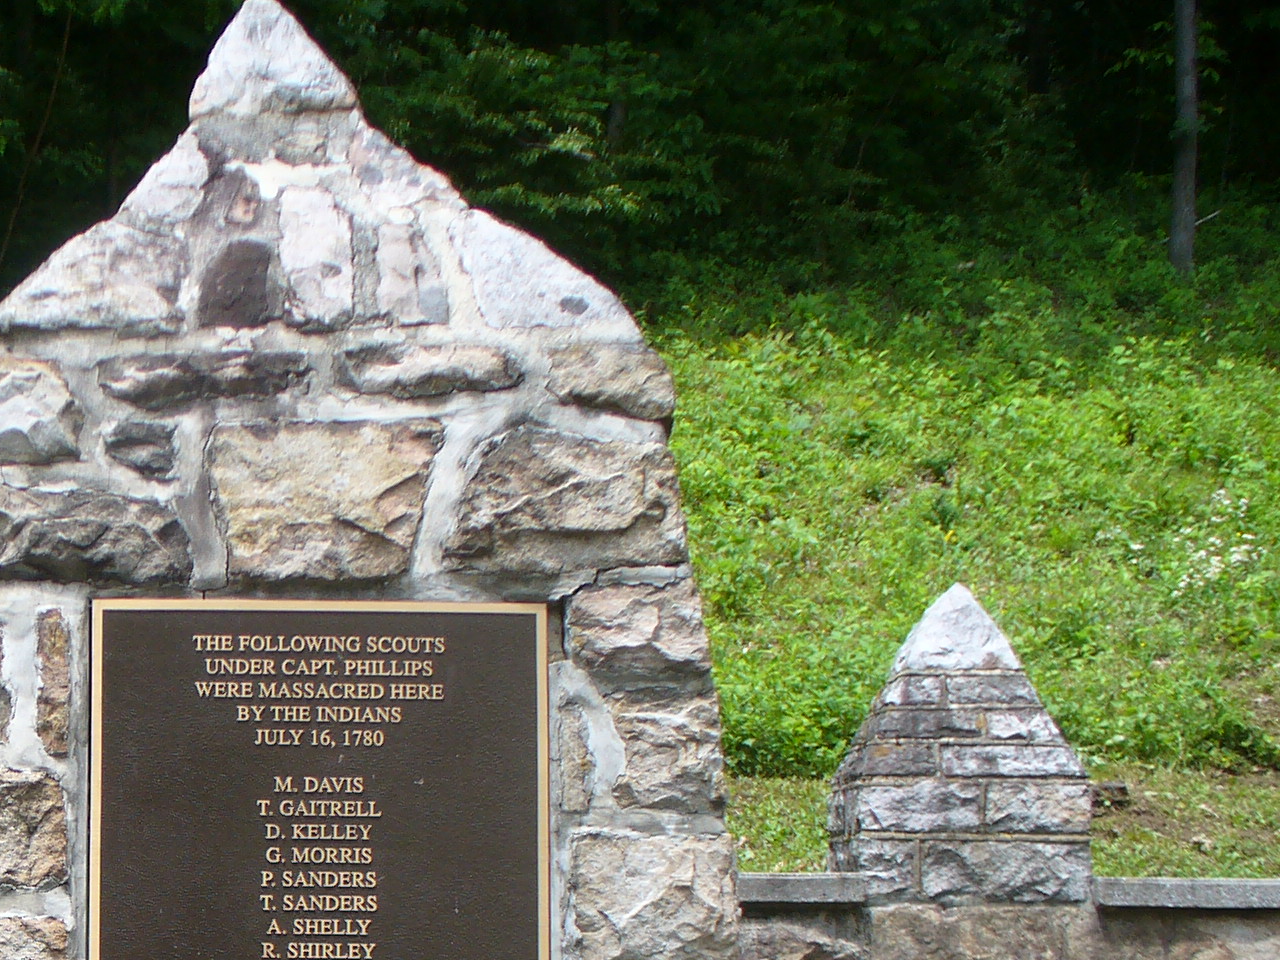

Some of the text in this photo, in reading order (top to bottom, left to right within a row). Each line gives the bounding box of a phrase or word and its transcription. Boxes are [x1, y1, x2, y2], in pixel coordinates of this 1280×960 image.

[191, 634, 446, 653] THE FOLLOWING SCOUTS
[204, 658, 433, 677] UNDER CAPT. PHILLIPS
[194, 680, 445, 700] WERE MASSACRED HERE
[236, 705, 402, 723] BY THE INDIANS
[254, 728, 385, 749] JULY 16, 1780
[273, 775, 364, 794] M. DAVIS
[256, 799, 383, 817] T. GAITRELL
[264, 823, 373, 841] D. KELLEY
[265, 846, 373, 864] G. MORRIS
[260, 870, 377, 888] P. SANDERS
[259, 894, 378, 912] T. SANDERS
[265, 918, 372, 936] A. SHELLY
[260, 941, 376, 960] R. SHIRLEY
